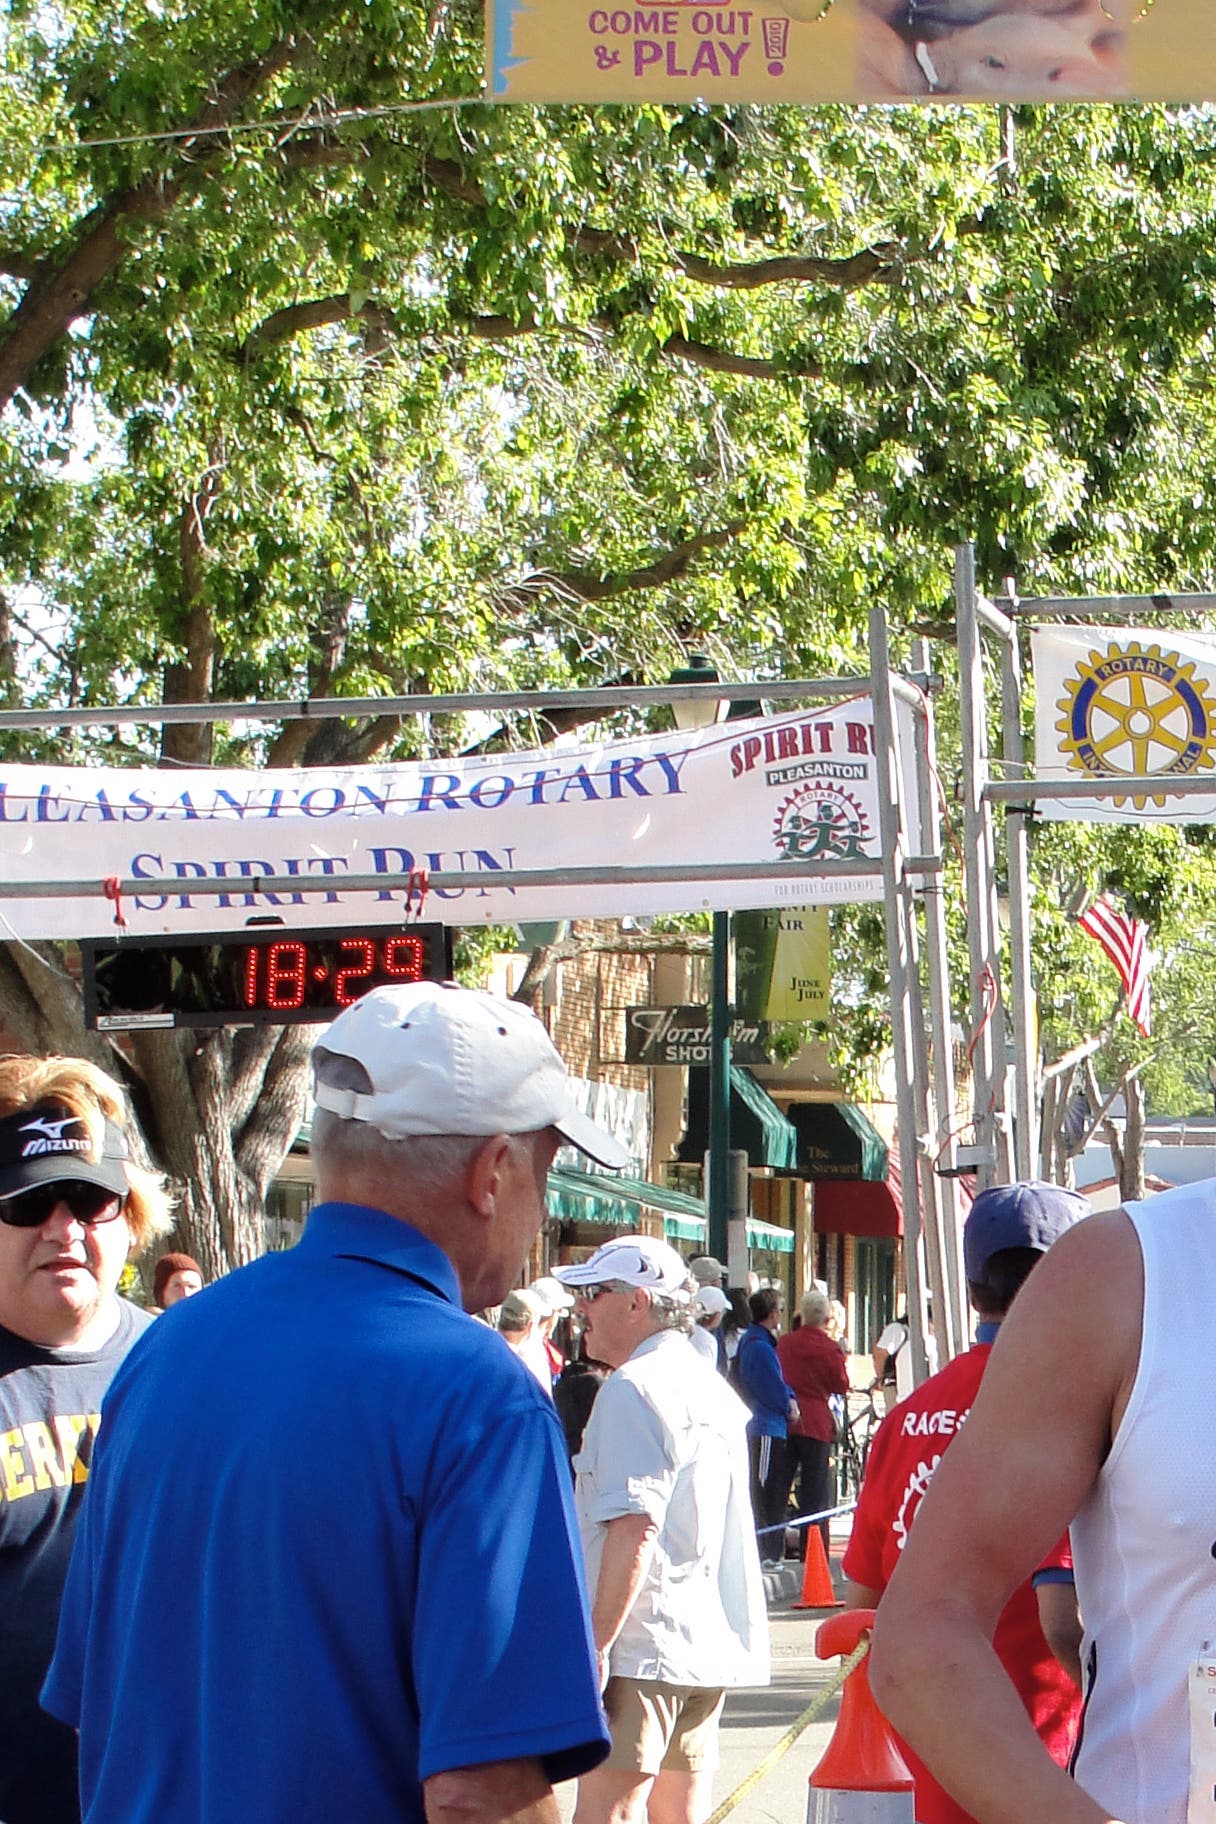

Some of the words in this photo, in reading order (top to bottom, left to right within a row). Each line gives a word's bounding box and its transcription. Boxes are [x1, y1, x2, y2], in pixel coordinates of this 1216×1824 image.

[588, 11, 680, 34] COME
[691, 11, 753, 35] OUT
[769, 22, 782, 53] 2010
[594, 45, 621, 70] &
[1101, 658, 1170, 677] ROTARY
[730, 722, 834, 778] SPIRIT
[412, 750, 693, 812] ROTARY
[769, 763, 864, 785] PLEASANTON
[799, 790, 838, 802] ROTARY
[131, 852, 348, 911] SPIRIT
[367, 847, 517, 901] RUN
[764, 916, 804, 931] FAIR
[790, 977, 820, 990] JUNE
[798, 988, 825, 1002] JULY
[666, 1046, 733, 1061] SHO
